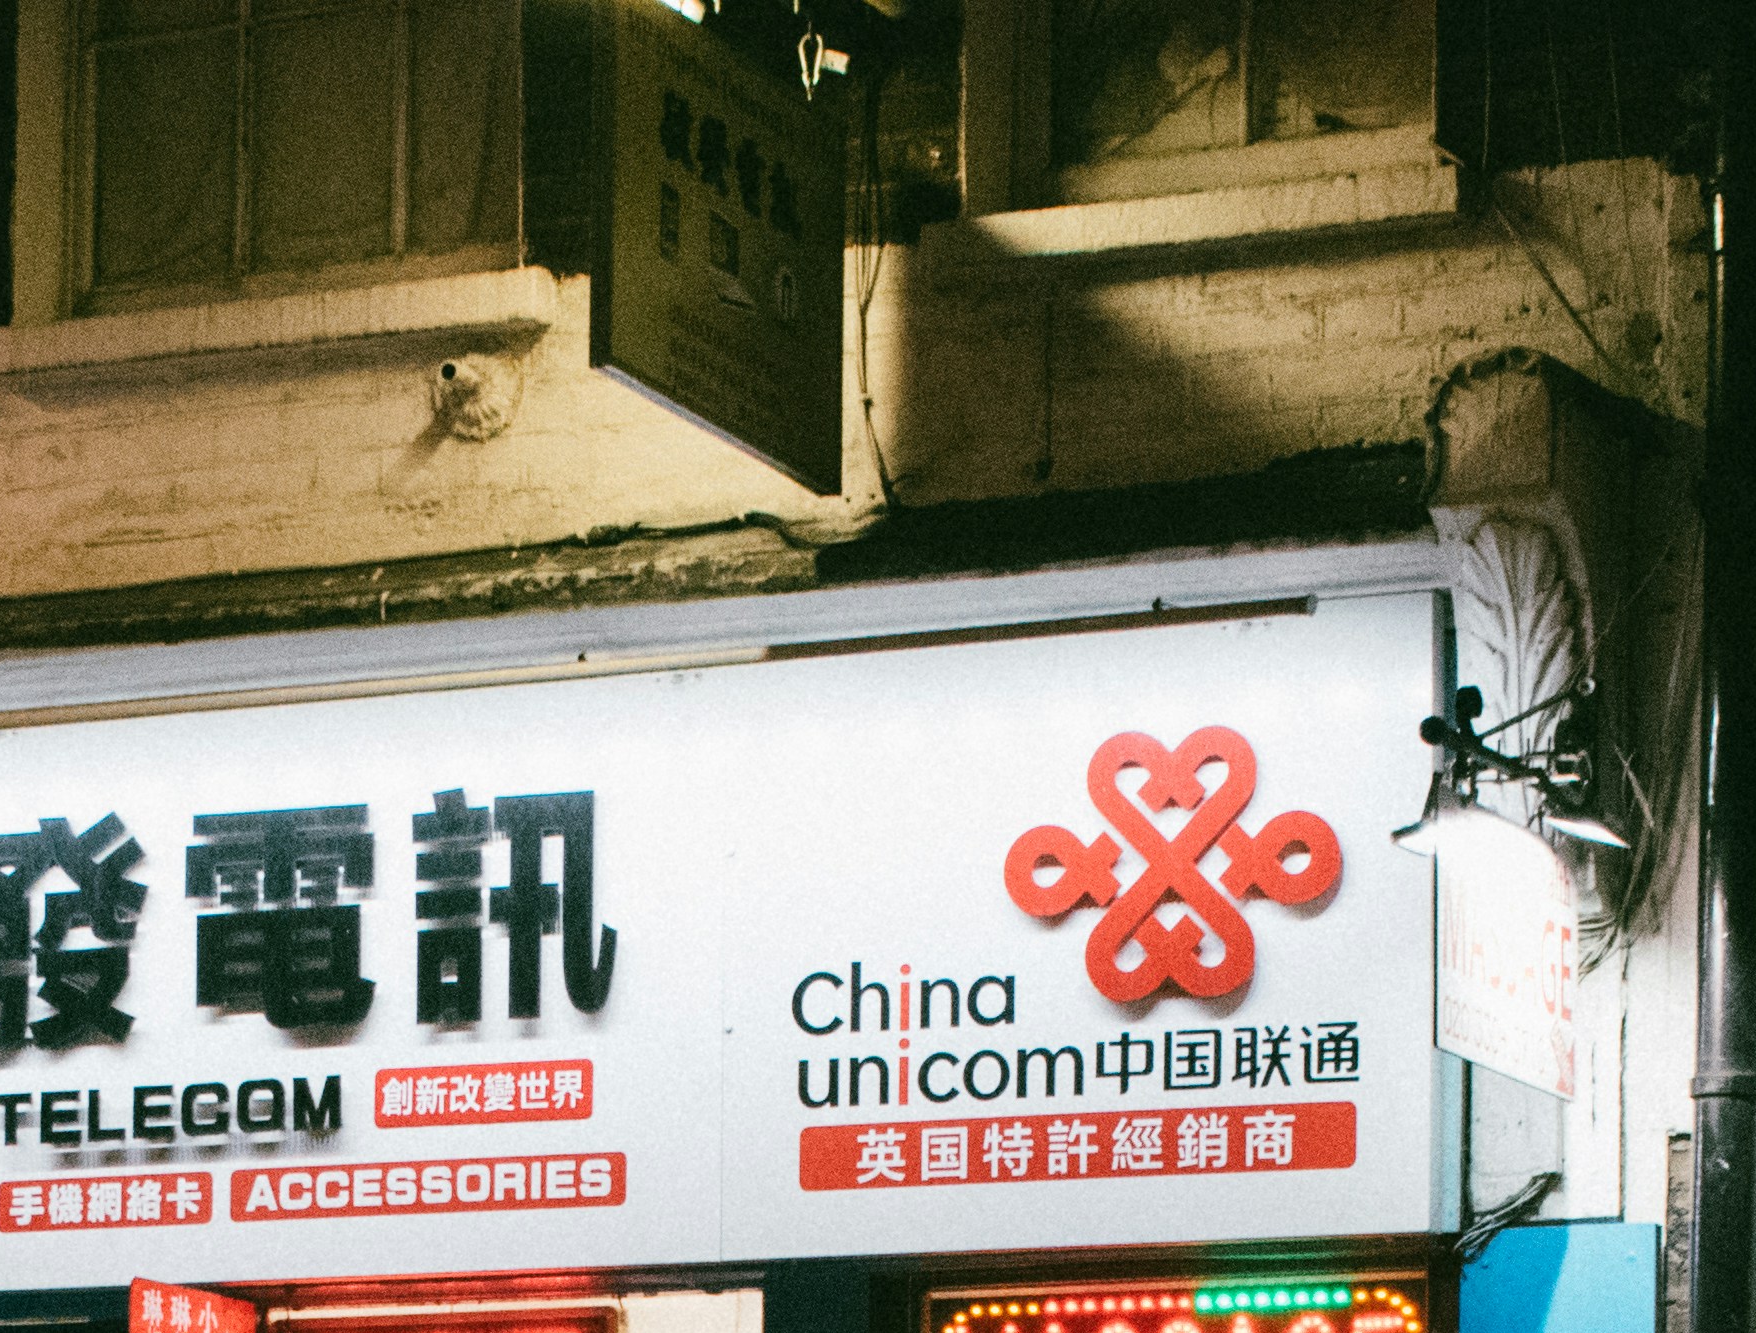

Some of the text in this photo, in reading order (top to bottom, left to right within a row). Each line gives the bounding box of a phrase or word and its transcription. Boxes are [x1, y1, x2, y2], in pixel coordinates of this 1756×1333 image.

[791, 960, 1016, 1036] China
[381, 1069, 586, 1117] 創新改變世界
[798, 1037, 1085, 1109] unicom
[1095, 1021, 1360, 1095] 中国联通
[855, 1111, 1297, 1185] 英国特許經銷商
[8, 1179, 205, 1227] 手機網絡卡
[244, 1158, 614, 1214] ACCESSORIES
